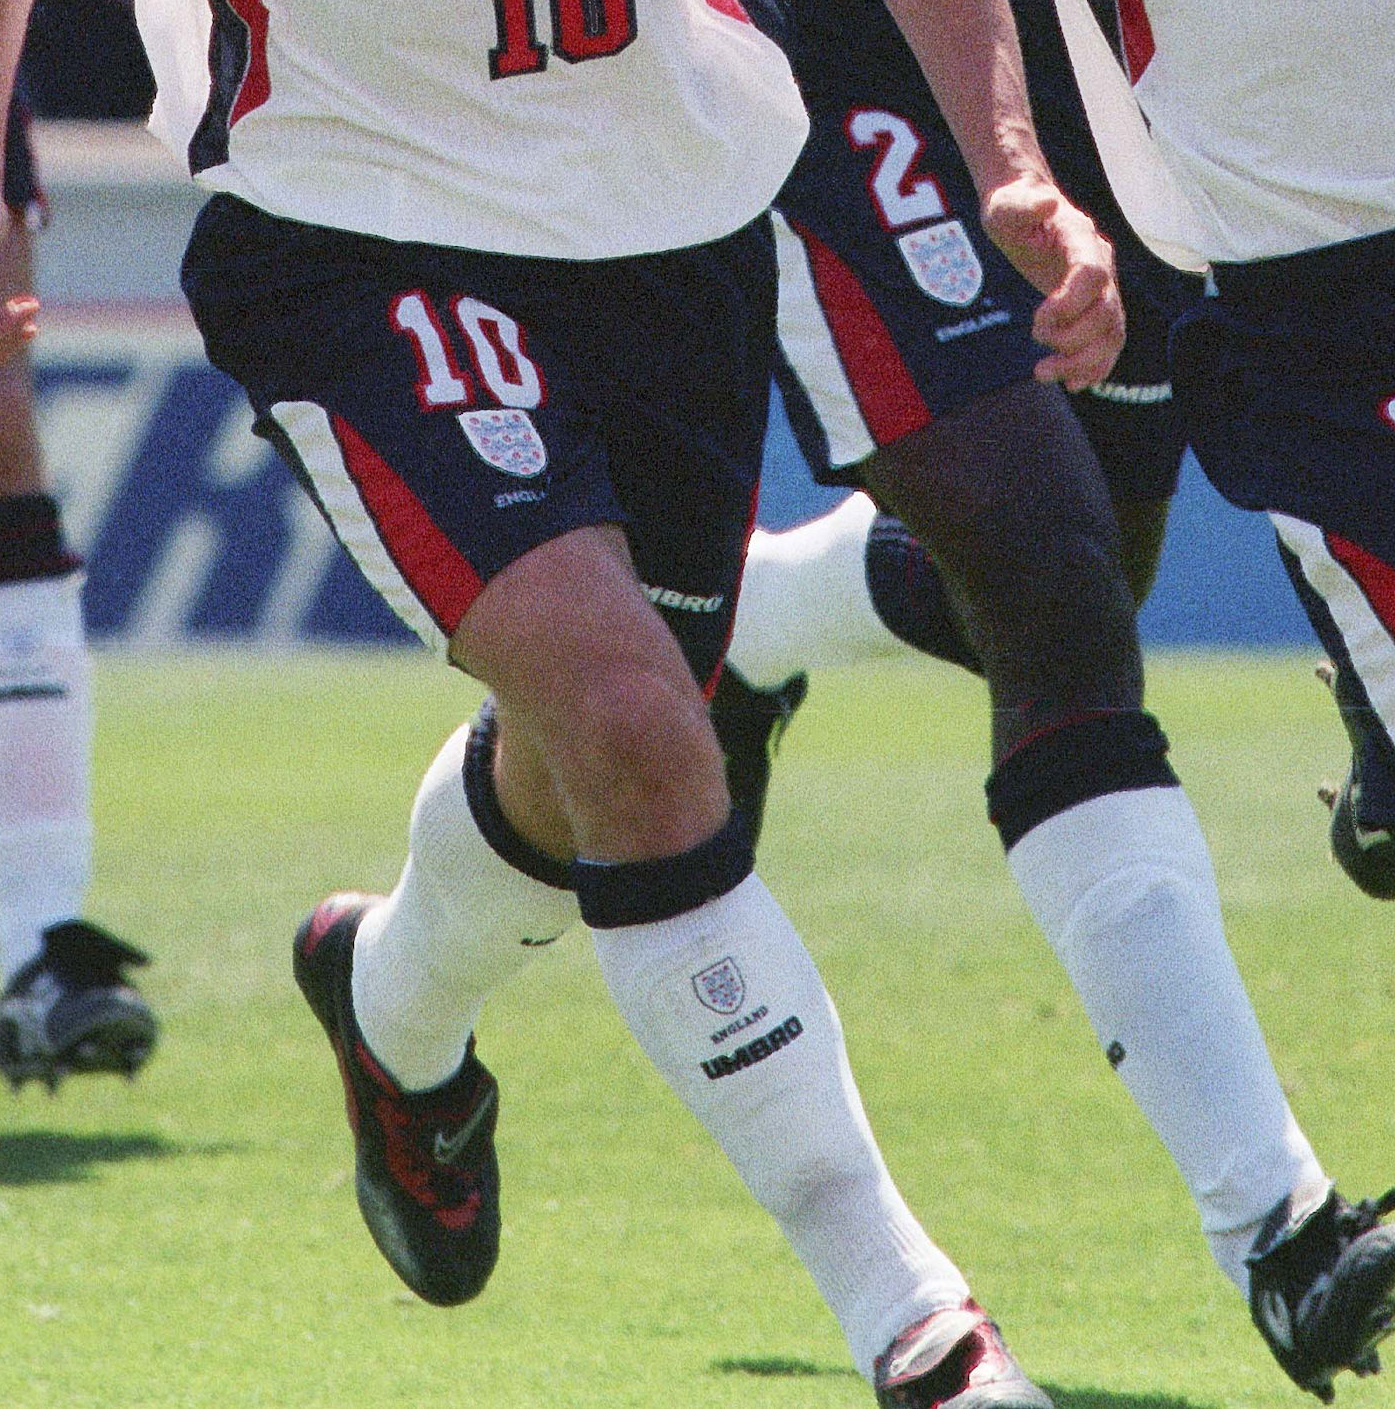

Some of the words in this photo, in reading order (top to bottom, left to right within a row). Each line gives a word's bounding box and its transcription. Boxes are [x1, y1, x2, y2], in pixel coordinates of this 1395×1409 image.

[843, 104, 950, 233] 2
[387, 287, 549, 413] 10
[639, 582, 725, 614] MBRO
[700, 1015, 804, 1080] UMBRO
[710, 1005, 768, 1044] ENGLAND
